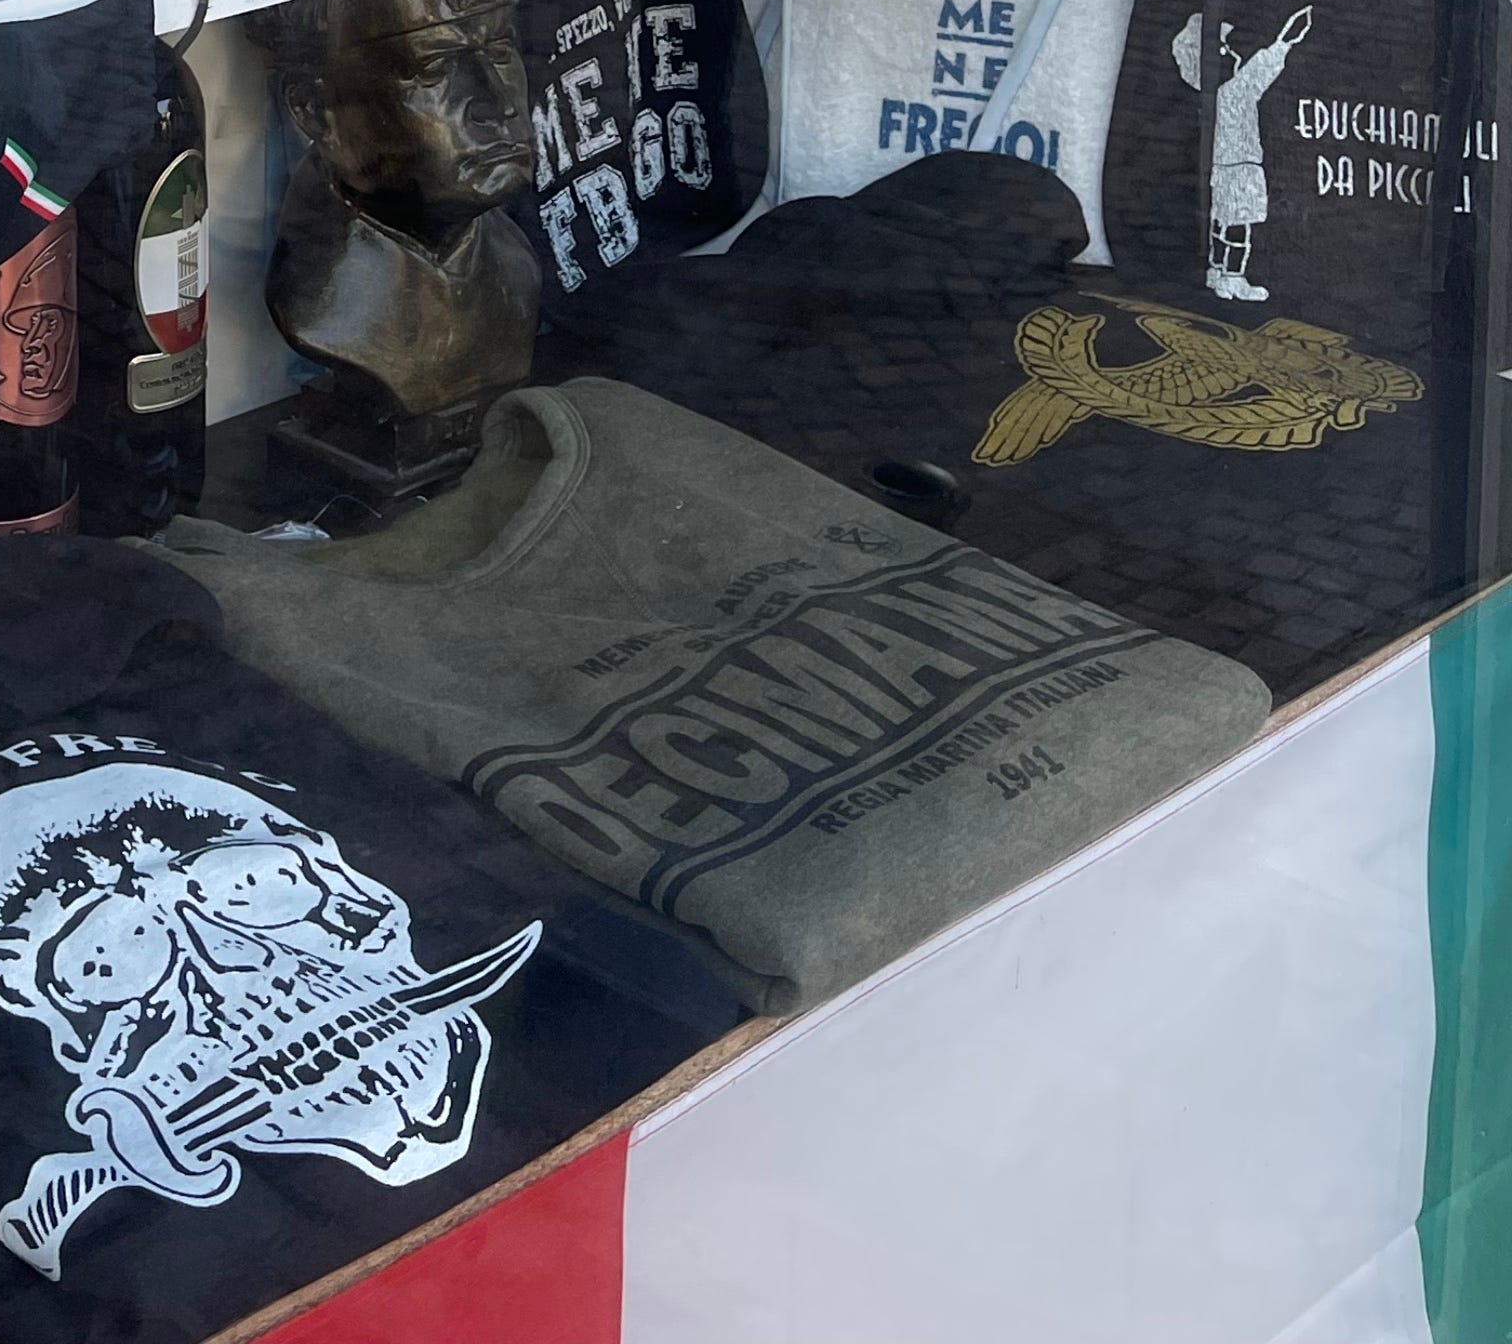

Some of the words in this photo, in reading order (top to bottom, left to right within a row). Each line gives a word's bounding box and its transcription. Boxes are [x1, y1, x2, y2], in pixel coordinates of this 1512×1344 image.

[1317, 154, 1354, 197] DA
[809, 780, 905, 837] REGIA
[900, 713, 1014, 791] MARINA
[1008, 661, 1128, 724] ITALIANA
[985, 744, 1067, 803] 1941
